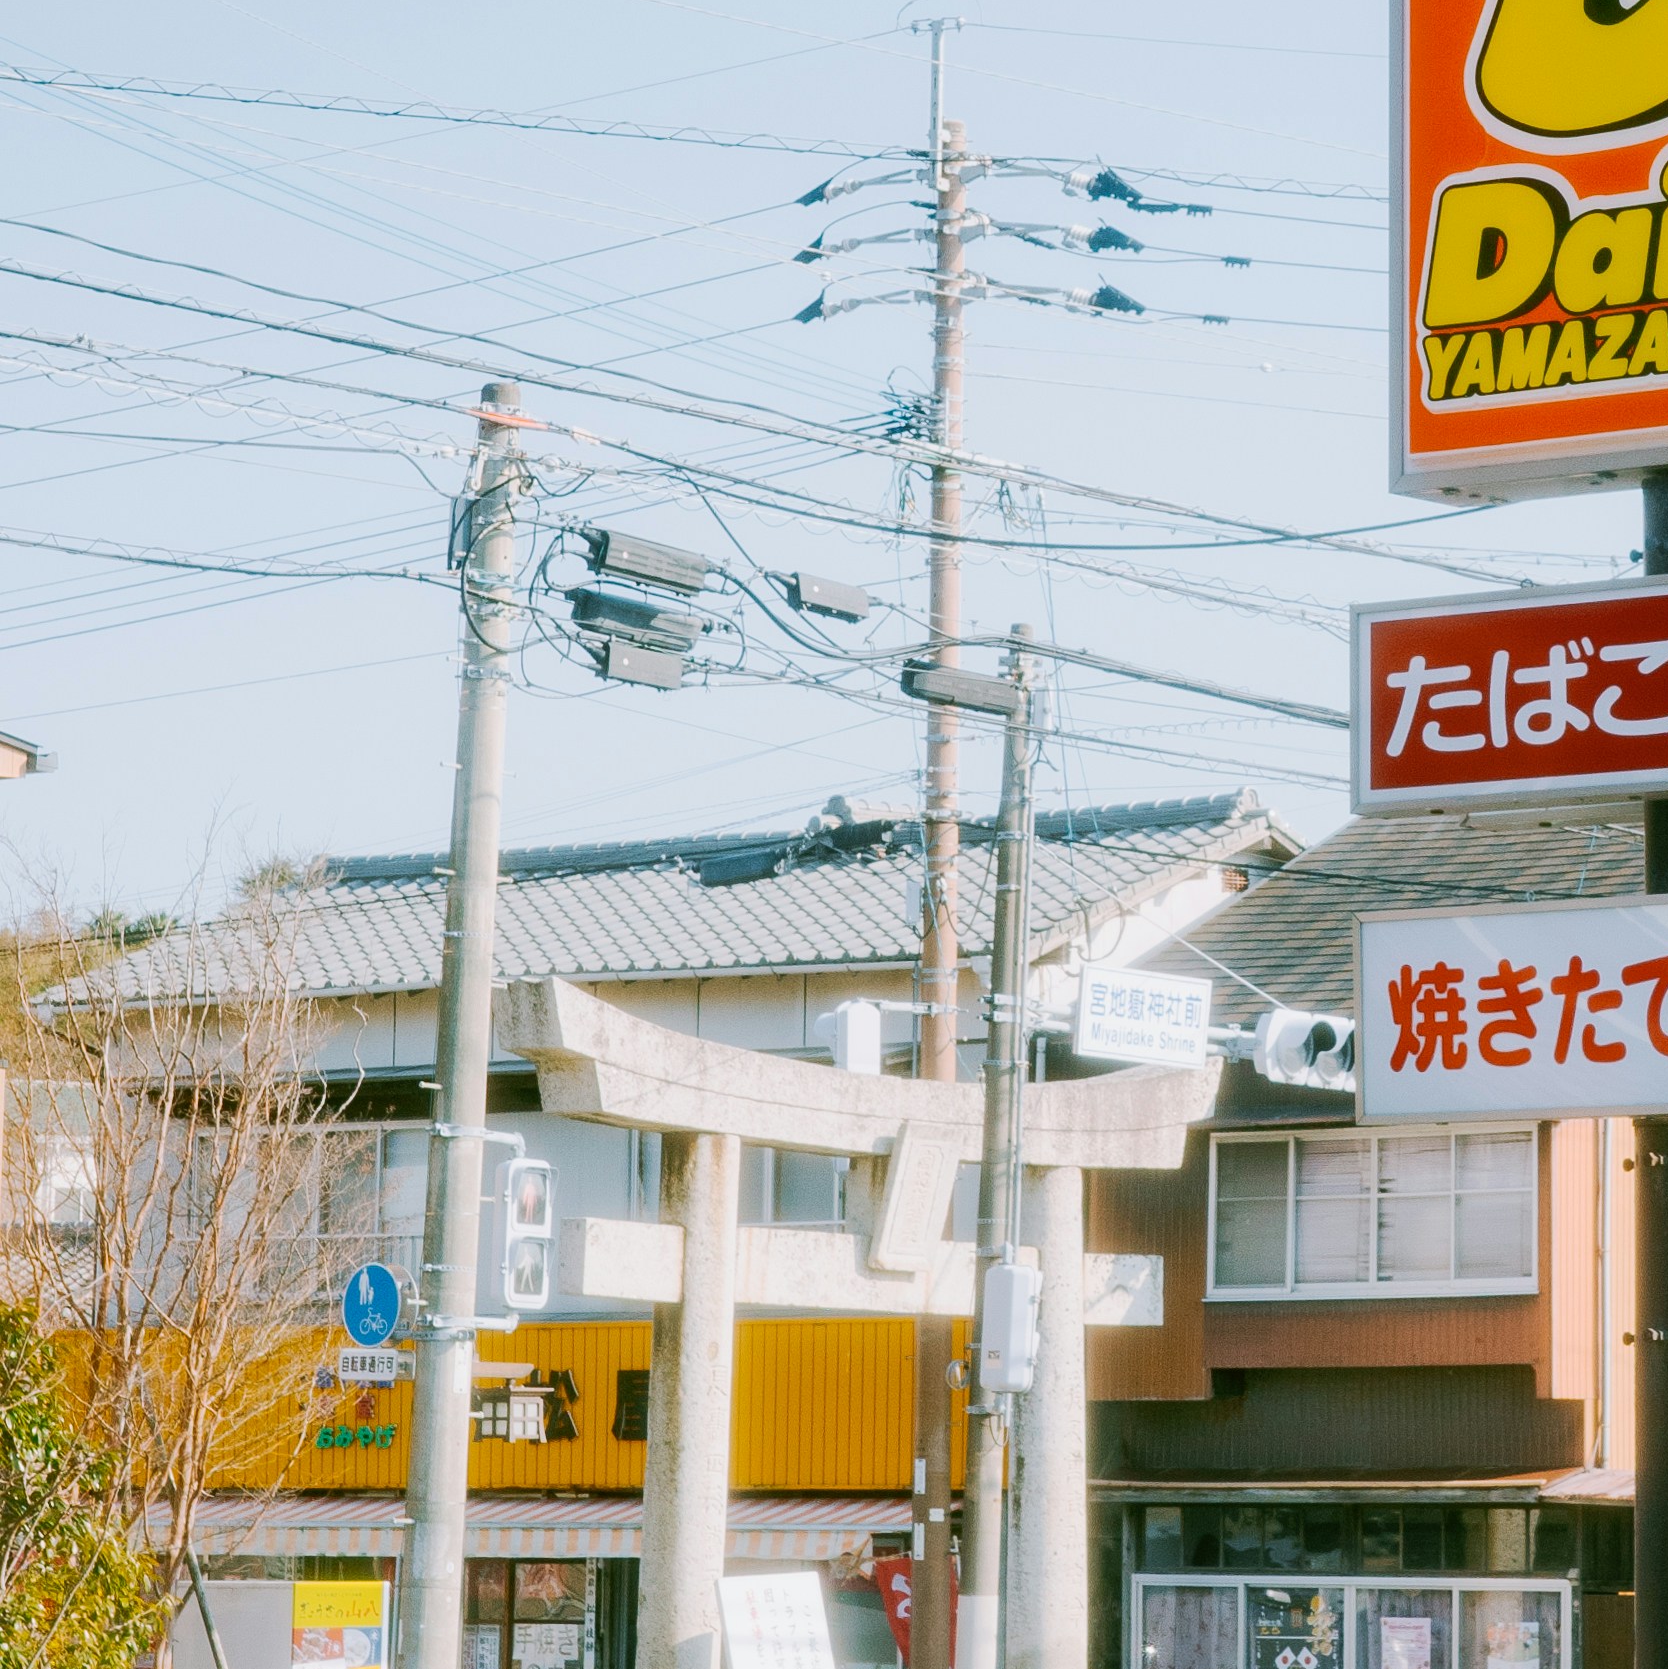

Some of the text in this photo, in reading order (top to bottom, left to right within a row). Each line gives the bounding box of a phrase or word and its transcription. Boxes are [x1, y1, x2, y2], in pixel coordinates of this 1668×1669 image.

[1089, 982, 1202, 1029] 宮地嶽神社前
[1091, 1021, 1196, 1053] Miyajidake Shrine
[341, 1355, 395, 1374] 自転車通行可
[315, 1423, 397, 1449] おみやげ
